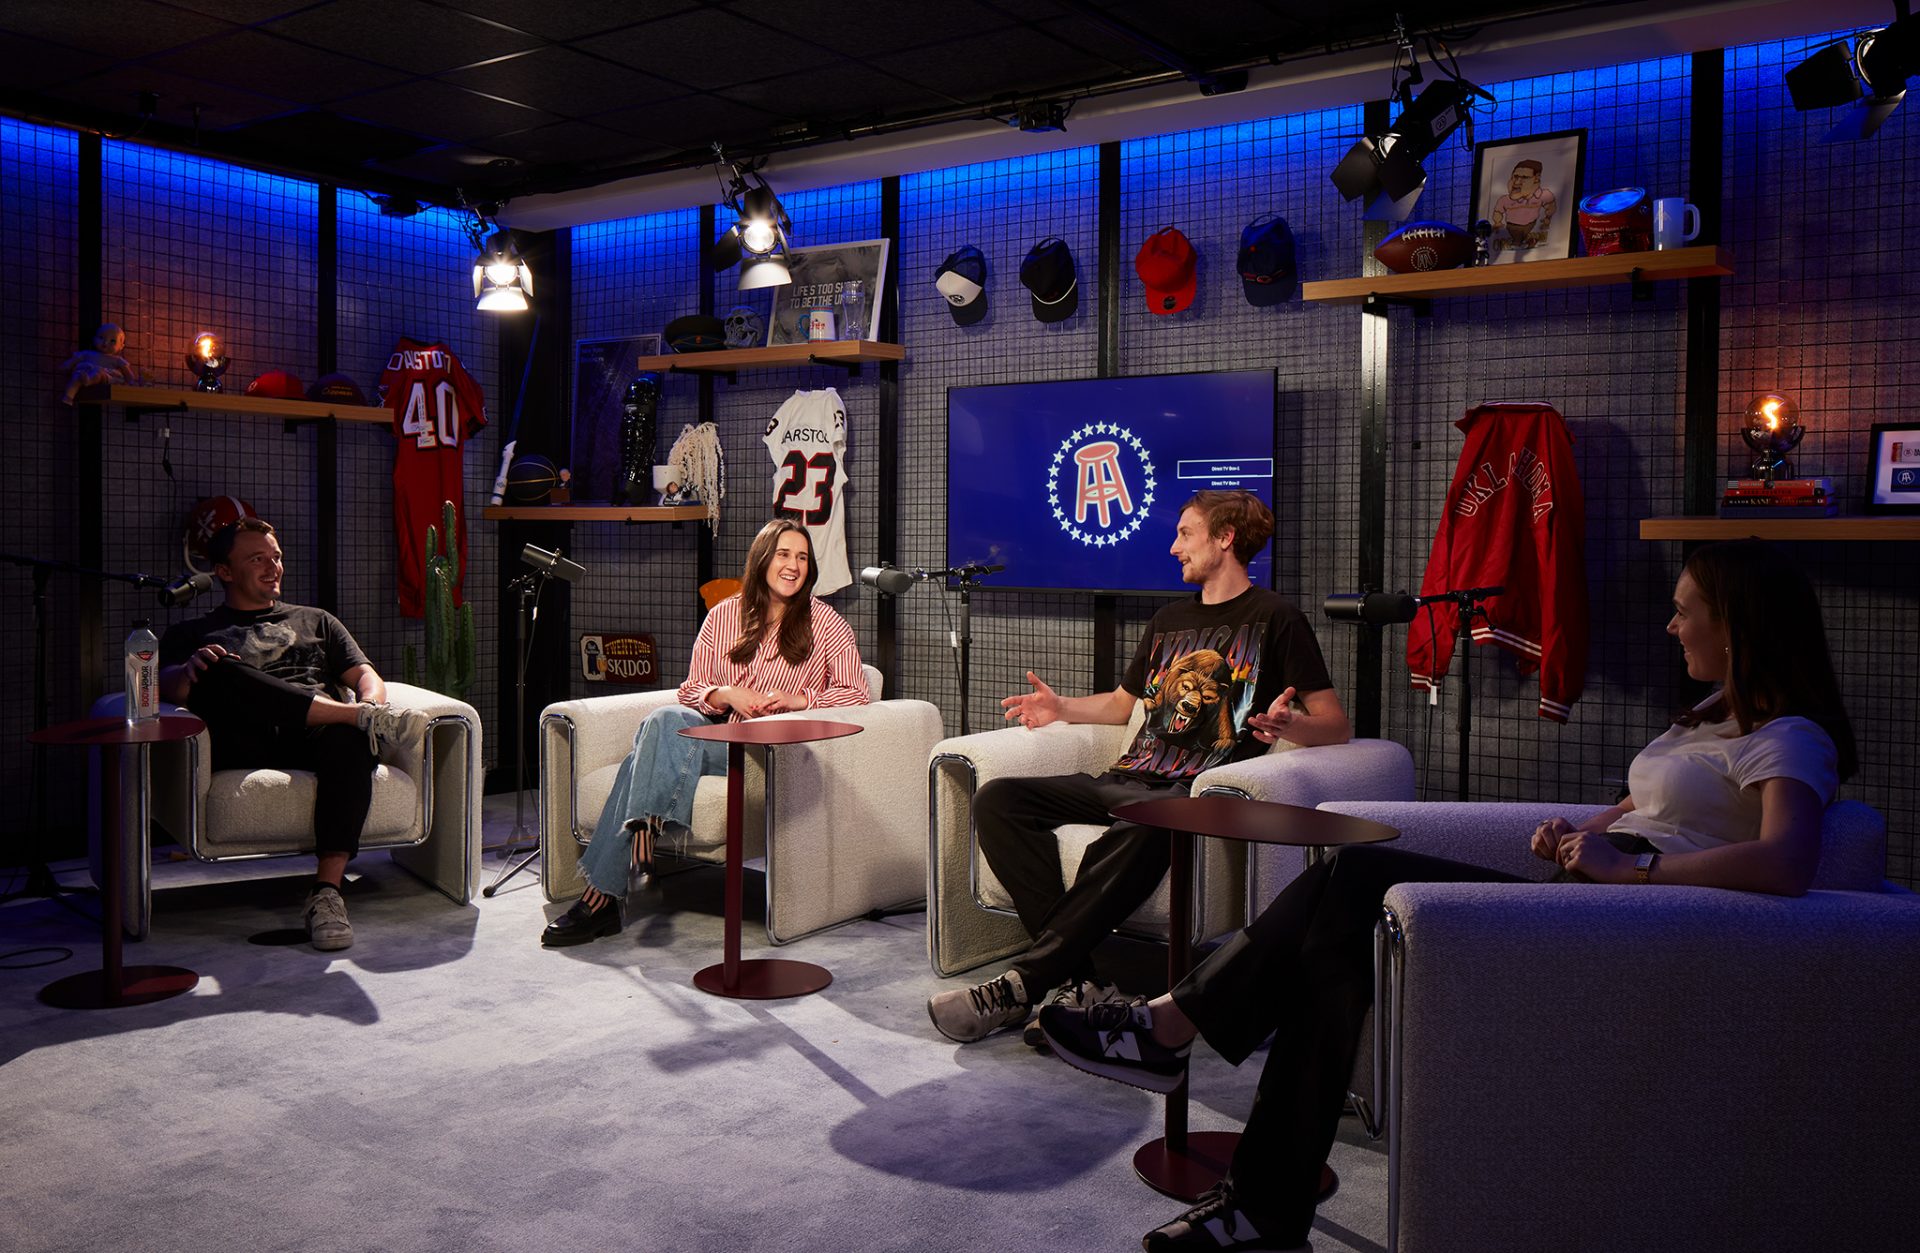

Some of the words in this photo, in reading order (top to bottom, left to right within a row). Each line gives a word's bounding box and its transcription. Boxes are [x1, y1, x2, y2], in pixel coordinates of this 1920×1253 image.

[793, 284, 816, 297] LIFE'S
[818, 283, 833, 295] TOO
[790, 298, 800, 309] TO
[802, 296, 817, 308] BET
[818, 295, 833, 306] THE
[402, 381, 460, 449] 40
[781, 428, 830, 444] ARSTO
[773, 449, 837, 526] 23
